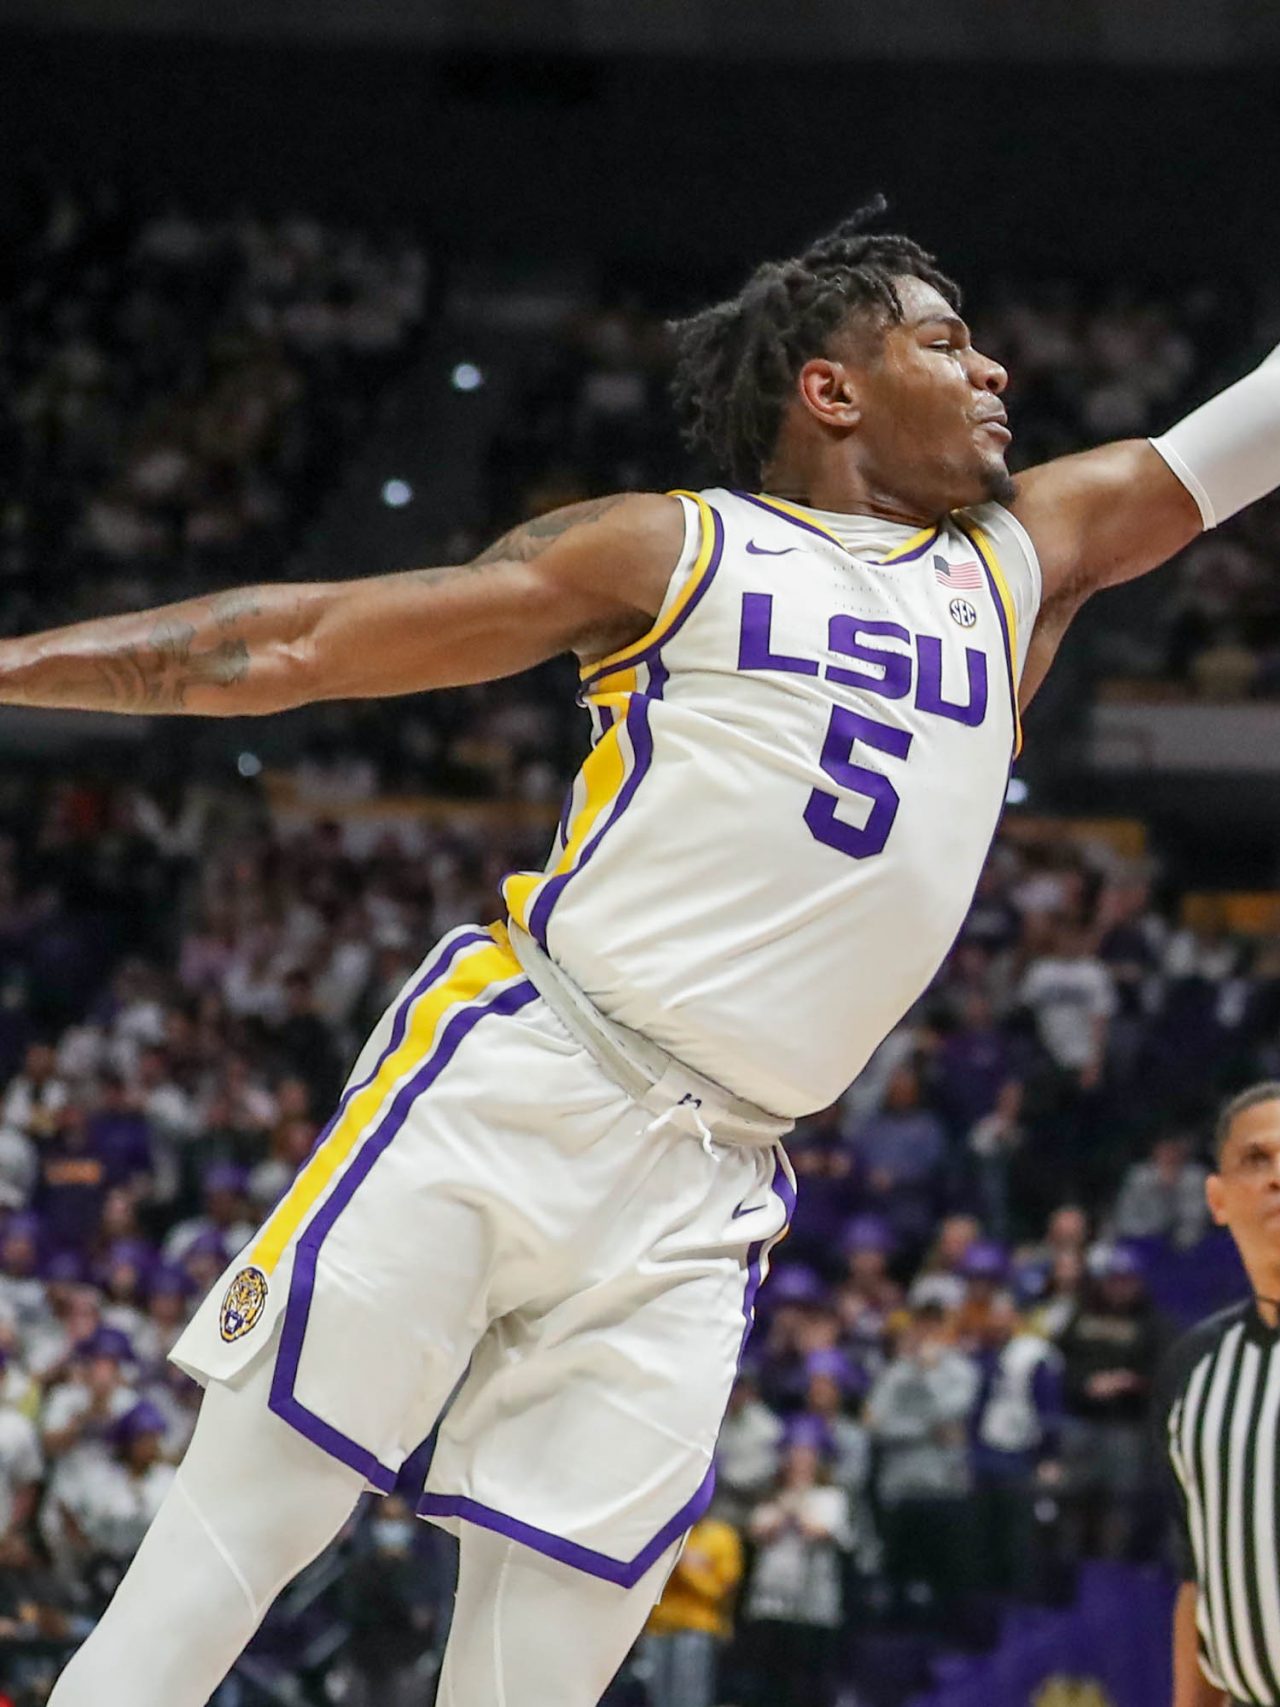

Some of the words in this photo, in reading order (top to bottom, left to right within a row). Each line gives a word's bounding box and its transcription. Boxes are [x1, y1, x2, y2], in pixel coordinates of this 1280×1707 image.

[737, 592, 988, 727] LSU
[950, 599, 976, 627] SEC
[803, 704, 913, 860] 5
